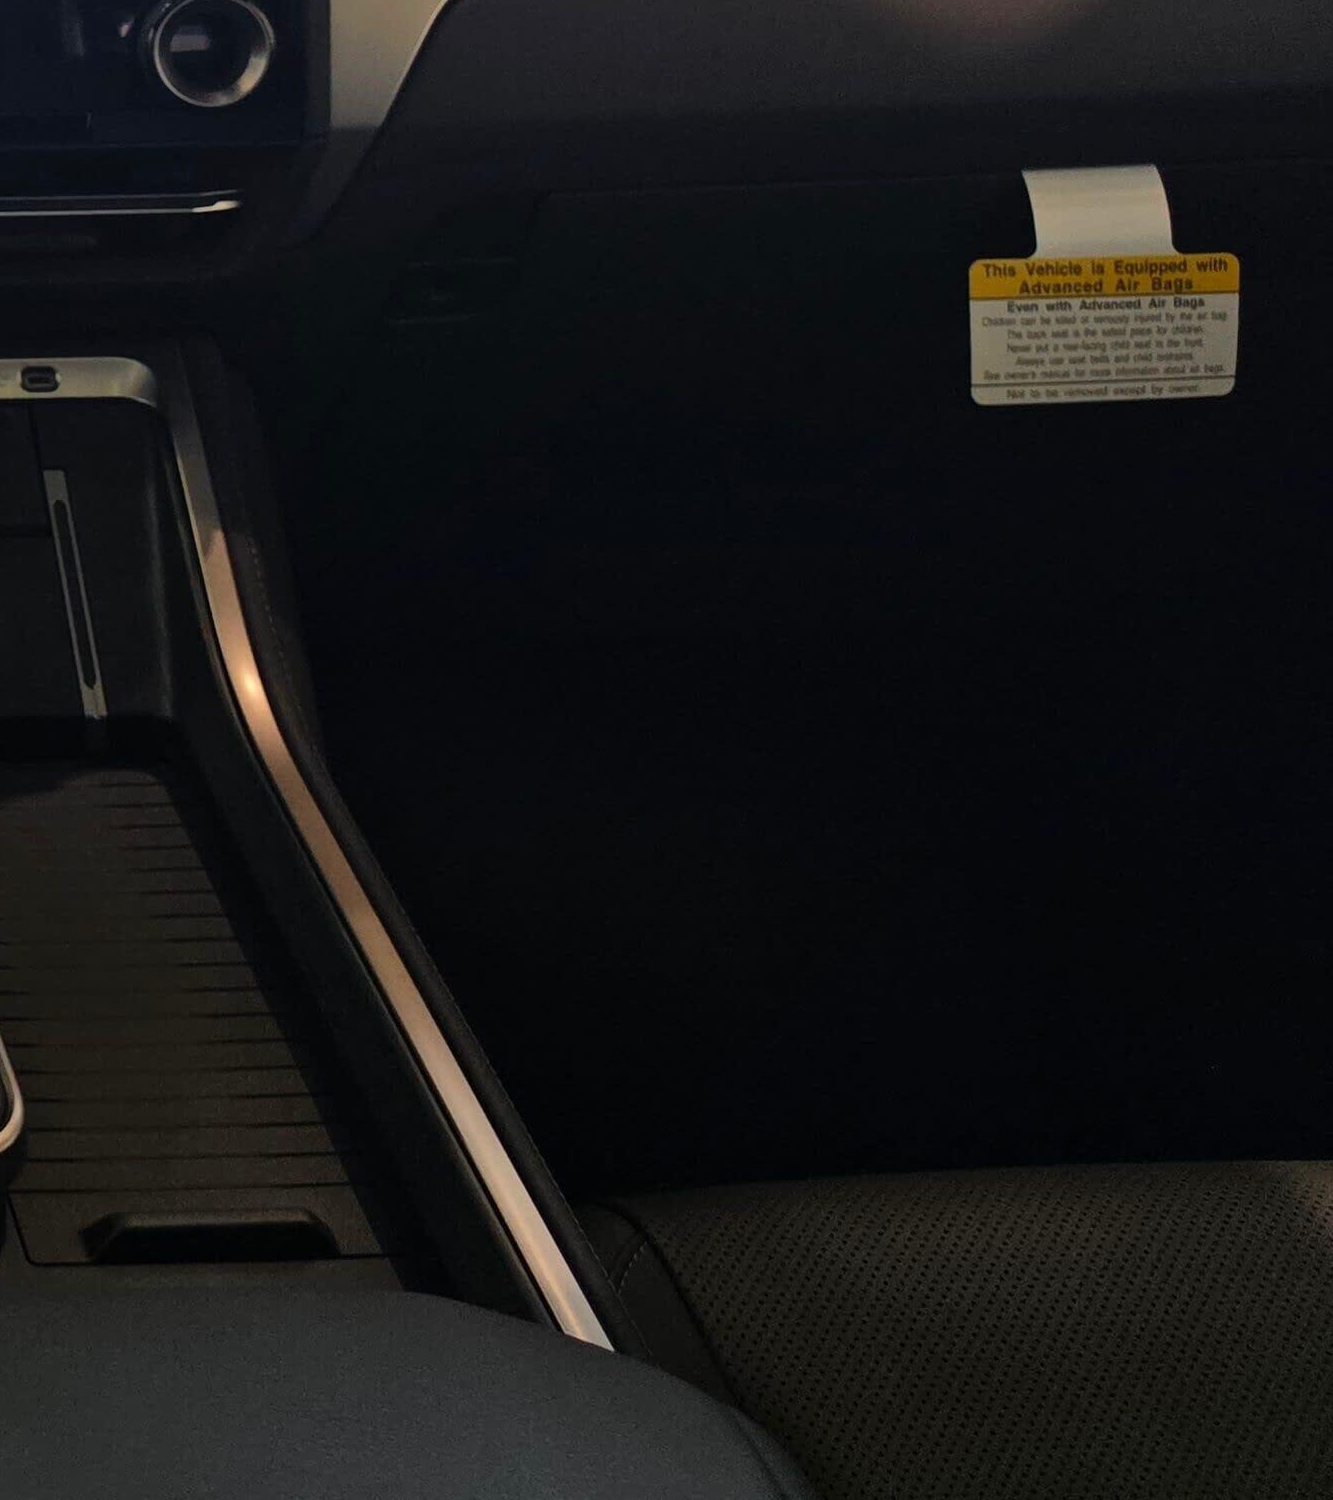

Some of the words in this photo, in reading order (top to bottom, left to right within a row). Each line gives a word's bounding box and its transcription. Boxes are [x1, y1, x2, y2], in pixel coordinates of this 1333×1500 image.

[983, 263, 1016, 277] This
[1025, 260, 1082, 276] Vehicle
[1091, 260, 1105, 275] is
[1114, 259, 1187, 276] Equipped
[1196, 257, 1228, 272] with
[1019, 280, 1103, 294] Advanced
[1116, 278, 1140, 291] Air
[1151, 277, 1193, 293] Bags
[1007, 301, 1038, 312] Even
[1046, 300, 1072, 311] with
[1080, 298, 1141, 310] Advanced
[1148, 297, 1166, 308] Air
[1173, 296, 1205, 309] Bags
